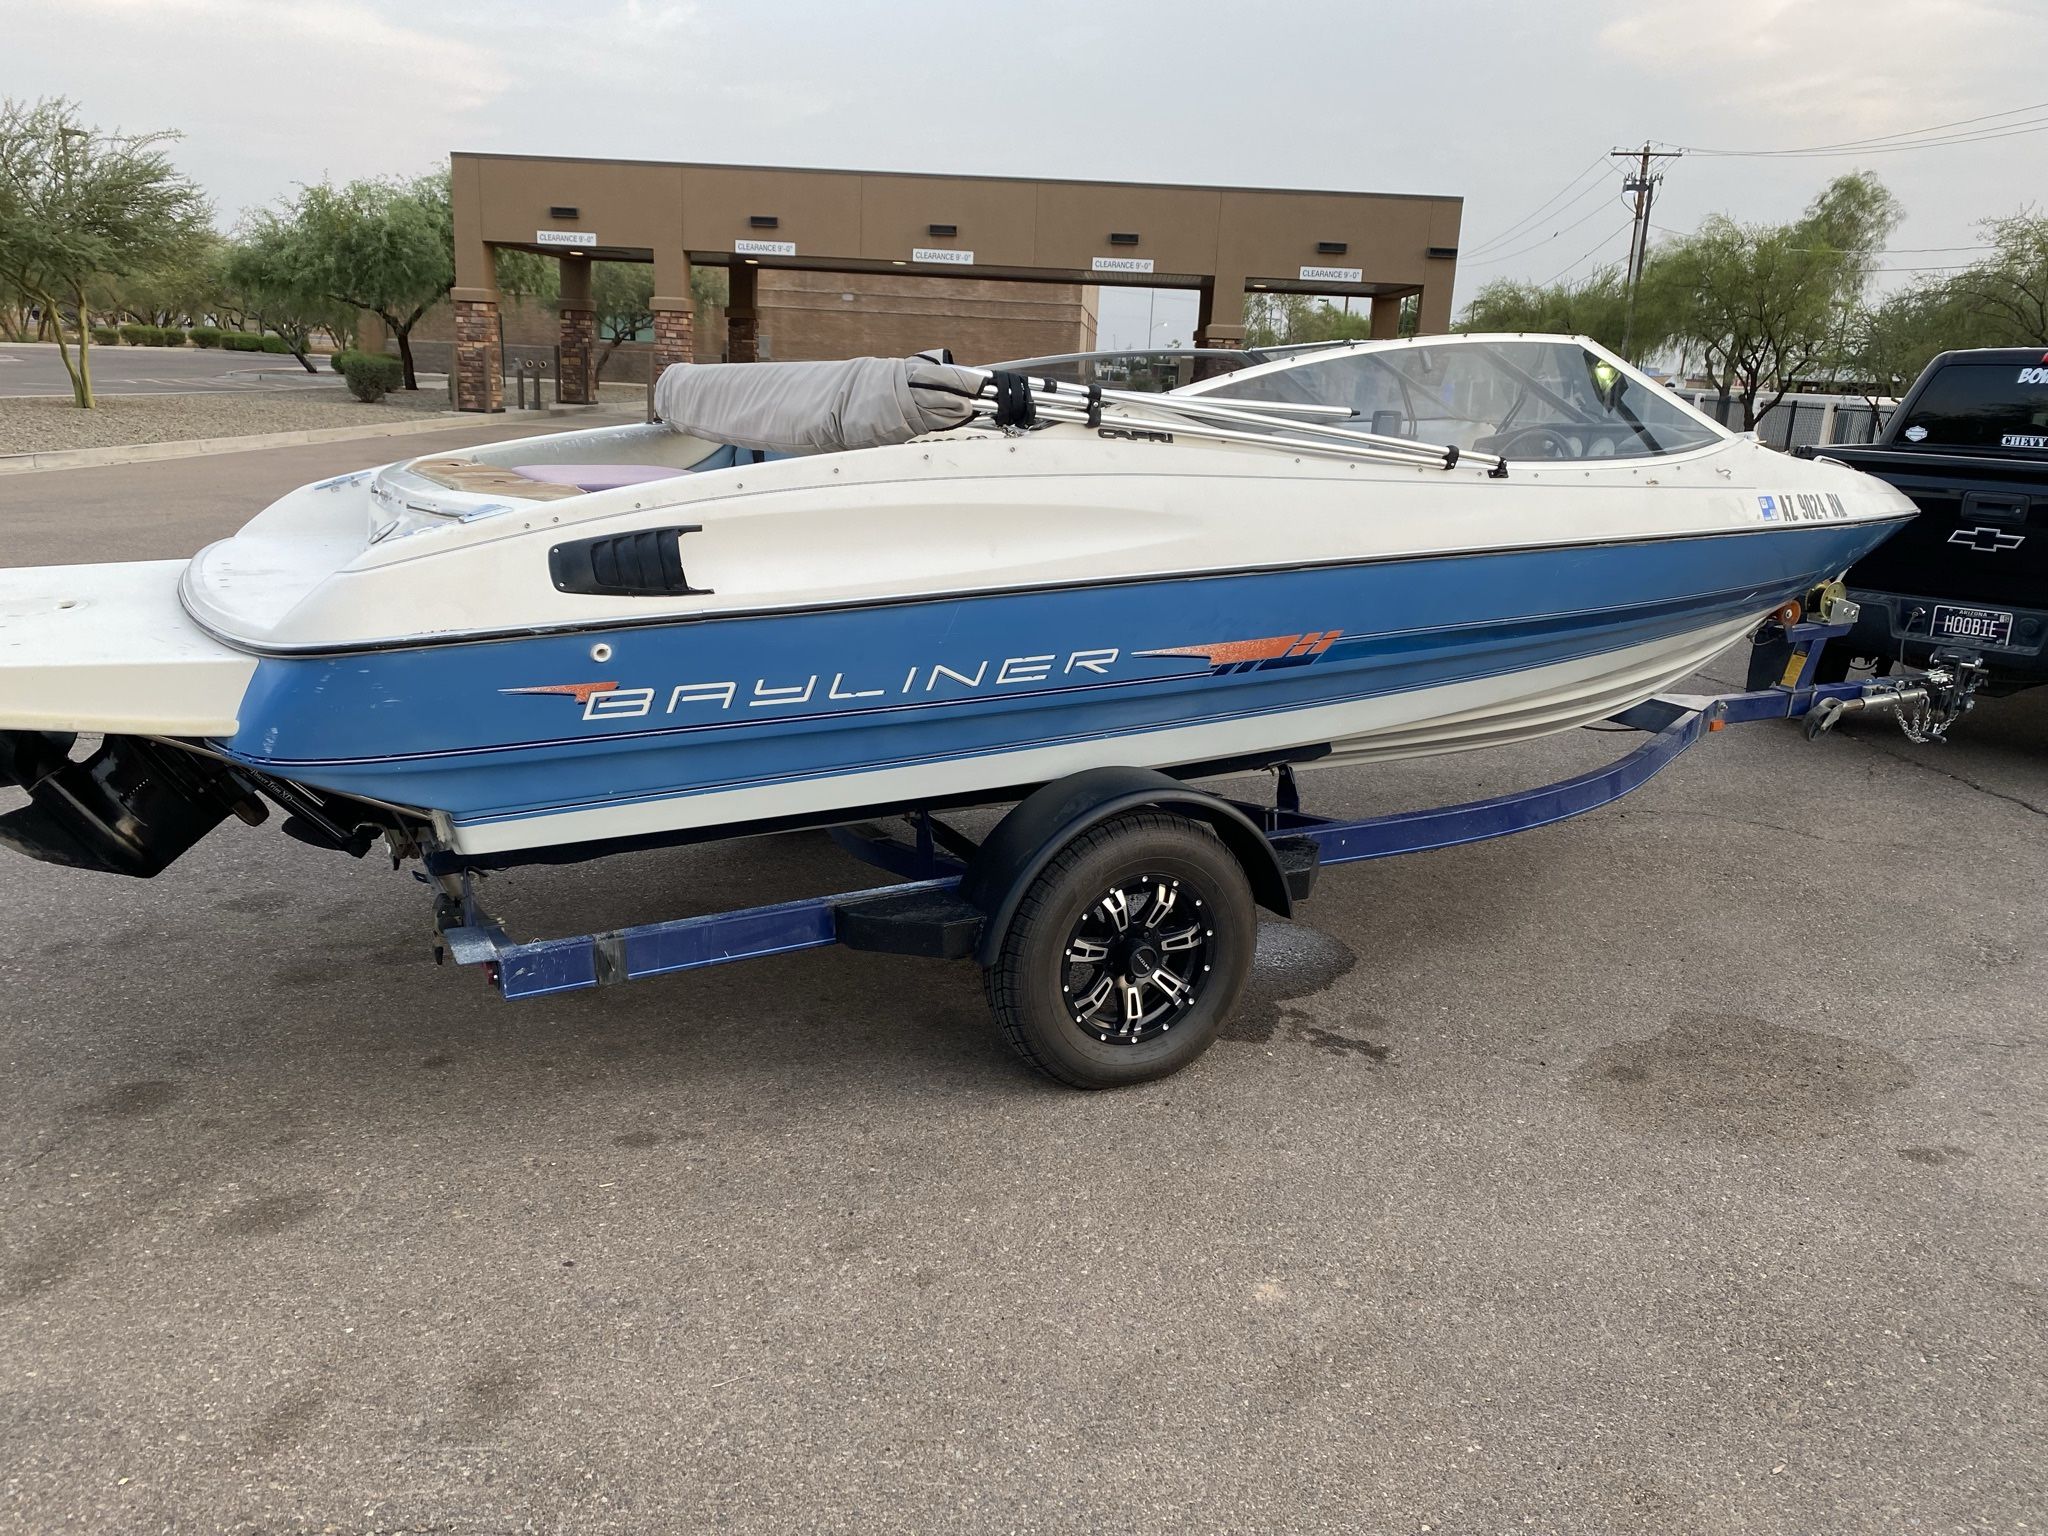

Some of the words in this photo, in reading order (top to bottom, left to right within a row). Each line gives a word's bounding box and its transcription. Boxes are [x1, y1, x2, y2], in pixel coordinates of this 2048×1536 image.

[540, 233, 578, 243] CLEARANCE
[738, 243, 777, 252] CLEARANCE
[777, 244, 793, 253] 9'-0"
[915, 251, 955, 261] CLEARANCE
[1095, 260, 1135, 269] CLEARANCE
[1135, 262, 1151, 270] 9'-0"
[1302, 269, 1343, 278] CLEARANCE
[1343, 271, 1360, 279] 9'-0"
[1098, 428, 1174, 444] CAPRI
[2001, 435, 2047, 447] CHEVY
[1778, 494, 1799, 521] AZ
[1797, 493, 1828, 520] 9024
[1959, 609, 1988, 617] ARIZONA
[1943, 615, 1999, 638] HOOBIE
[582, 648, 1119, 721] BAYLINER
[267, 780, 281, 794] Trim
